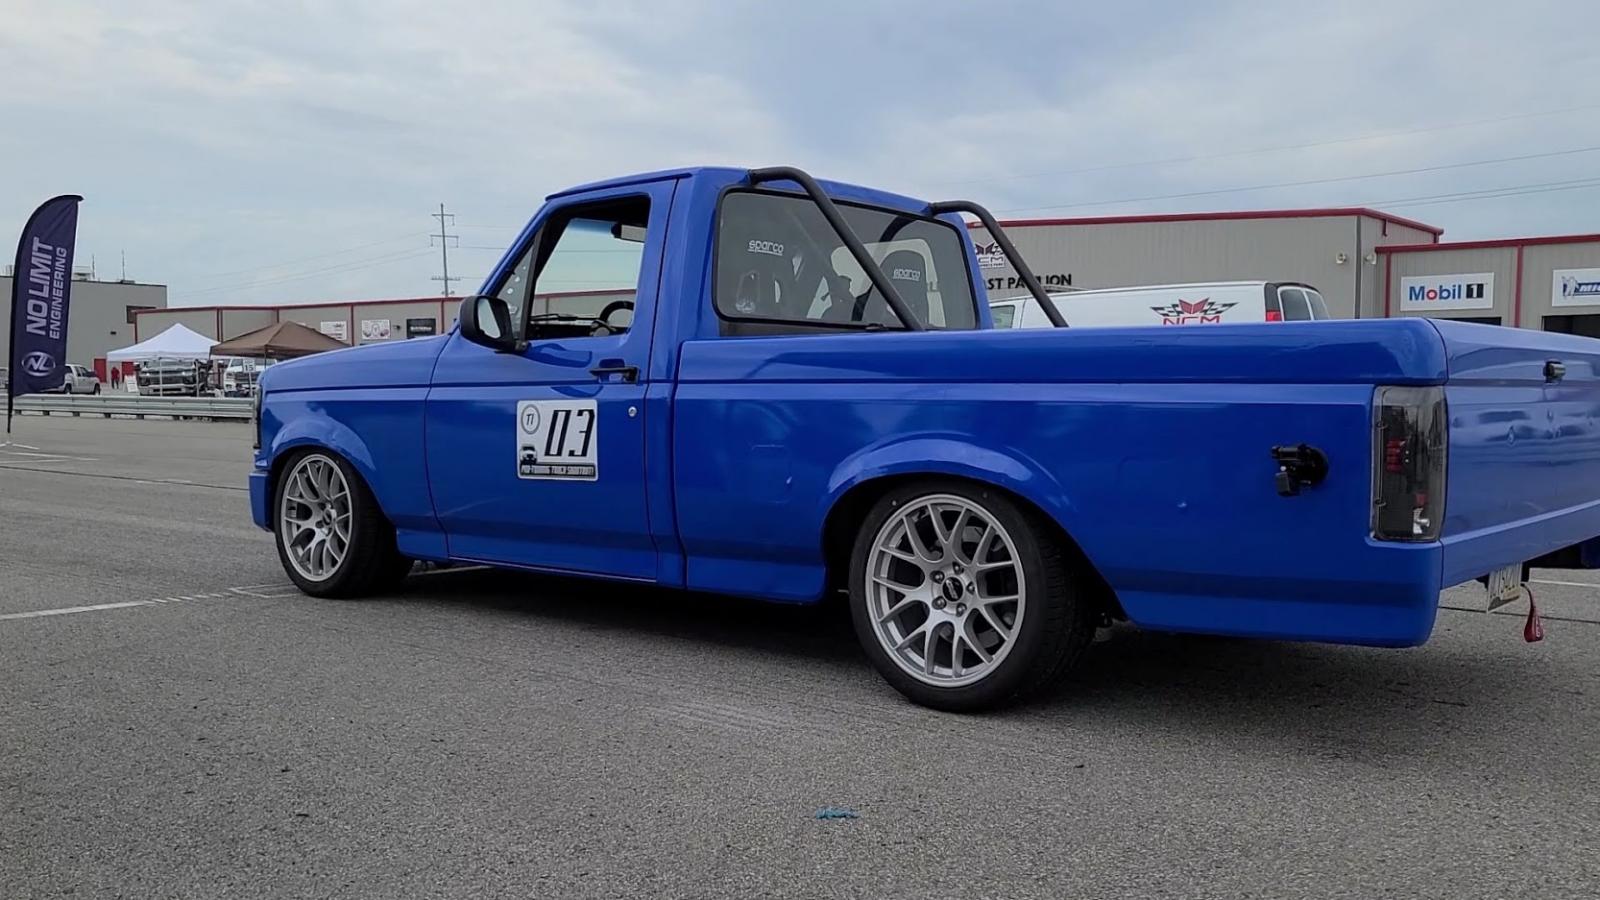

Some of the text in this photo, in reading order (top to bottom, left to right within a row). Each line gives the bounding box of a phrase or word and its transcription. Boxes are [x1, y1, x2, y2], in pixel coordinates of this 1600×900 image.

[747, 239, 784, 256] sparco
[978, 256, 1004, 264] CM
[892, 268, 921, 281] sparco
[26, 237, 54, 336] NO LIMIT
[985, 278, 1004, 290] ST
[1408, 283, 1482, 301] Mobil 1
[49, 247, 68, 340] ENGINEERING
[544, 409, 596, 457] 03
